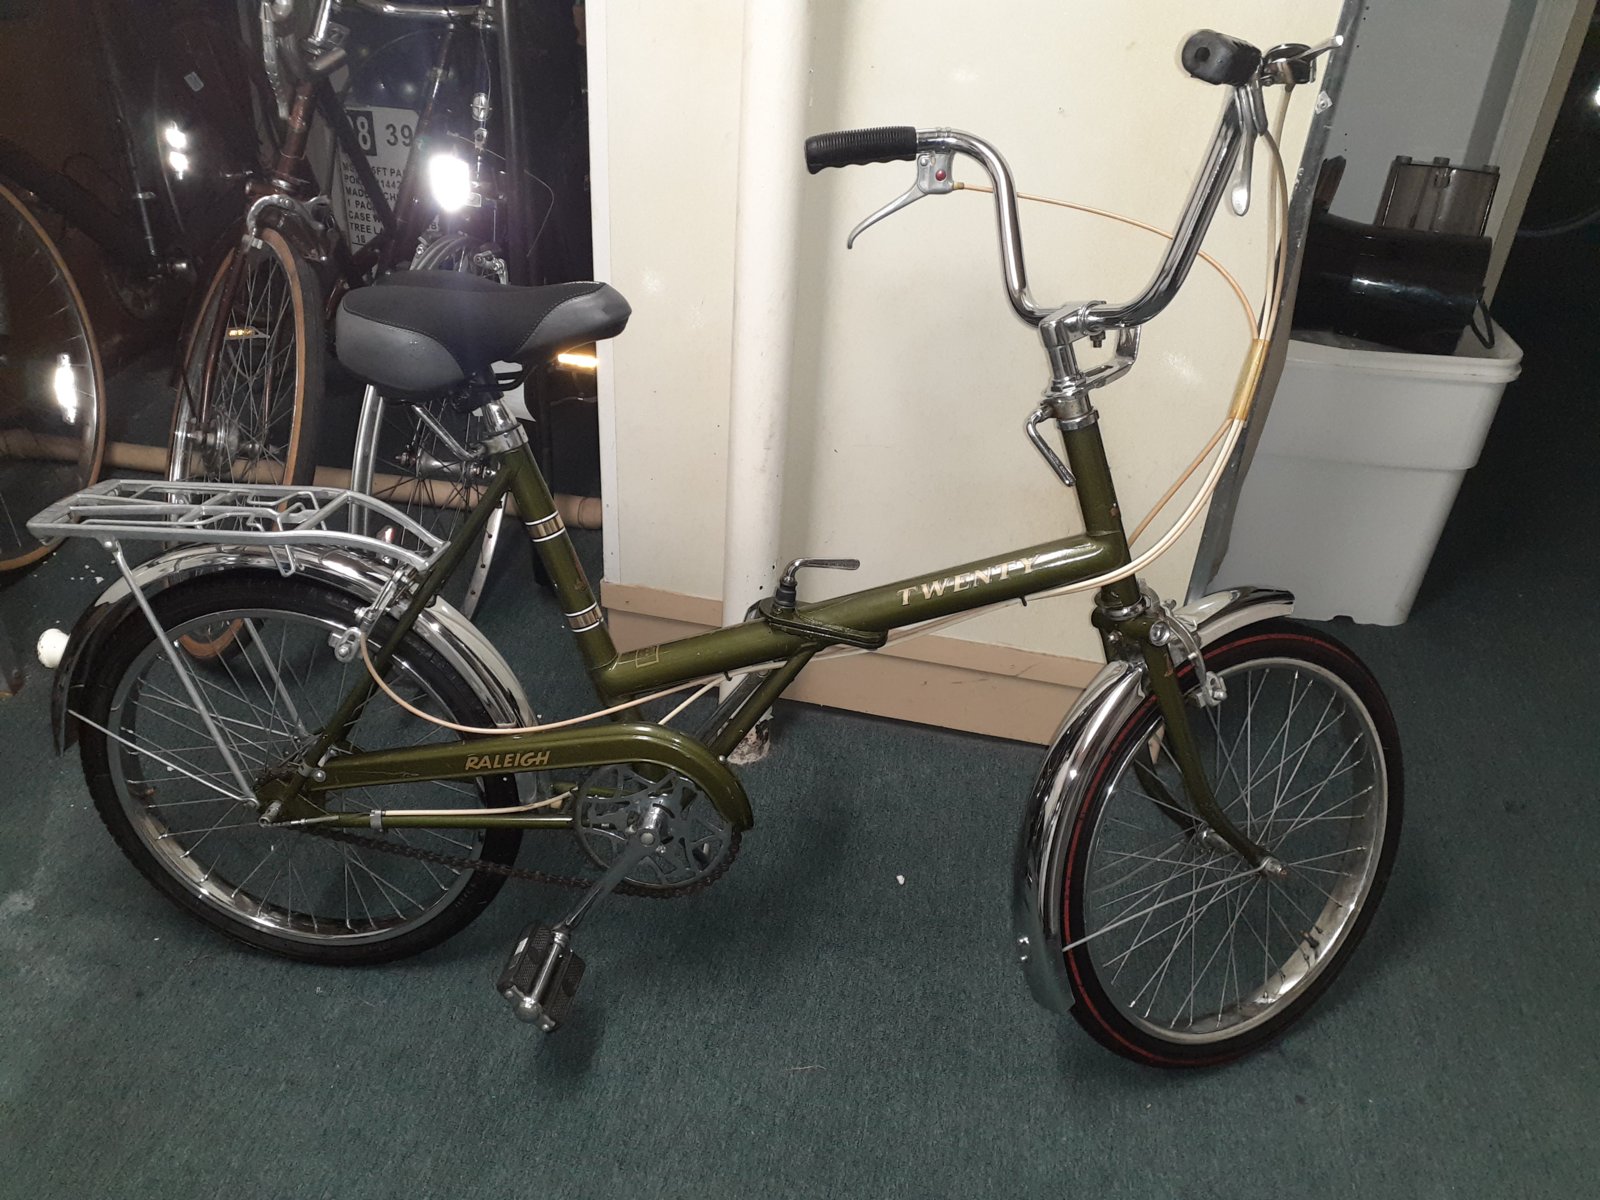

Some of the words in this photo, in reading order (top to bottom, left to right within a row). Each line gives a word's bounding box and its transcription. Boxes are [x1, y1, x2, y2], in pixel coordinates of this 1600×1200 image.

[346, 115, 371, 151] 8
[384, 123, 413, 148] 39
[355, 199, 373, 210] PAC
[348, 210, 371, 223] CASE
[349, 221, 372, 234] TREE
[896, 553, 1040, 606] TWENTY
[465, 751, 551, 770] RALEIGH
